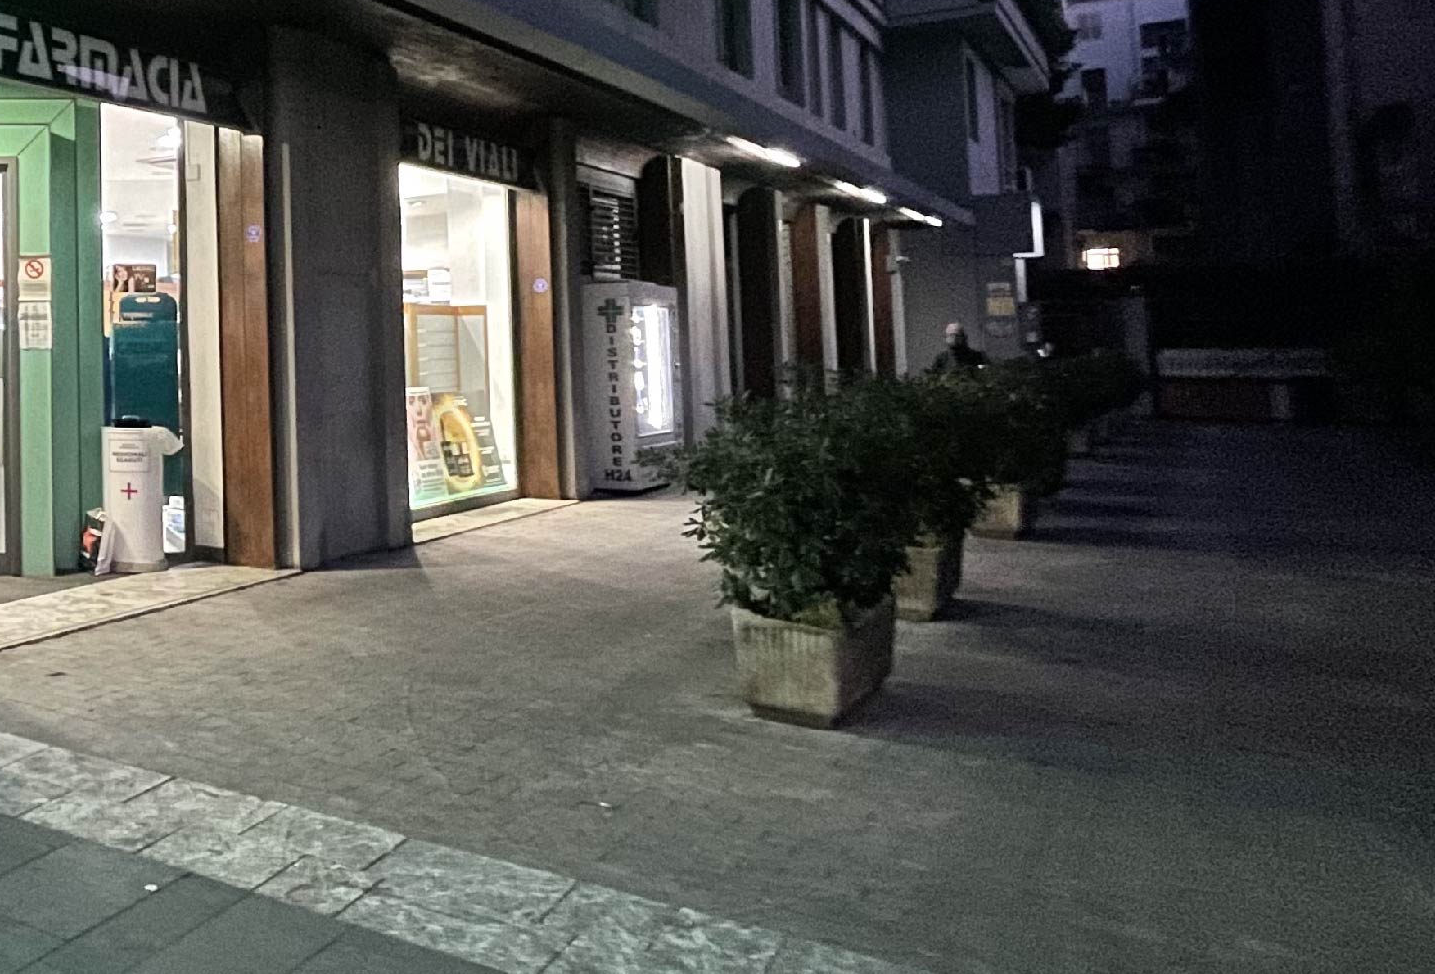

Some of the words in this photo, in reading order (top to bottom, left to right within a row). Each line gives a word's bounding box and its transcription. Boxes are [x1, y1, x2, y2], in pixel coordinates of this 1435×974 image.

[417, 122, 453, 166] DEI
[465, 135, 518, 182] VIALI
[606, 324, 623, 467] DISTRIBUTORE
[604, 469, 632, 482] H24
